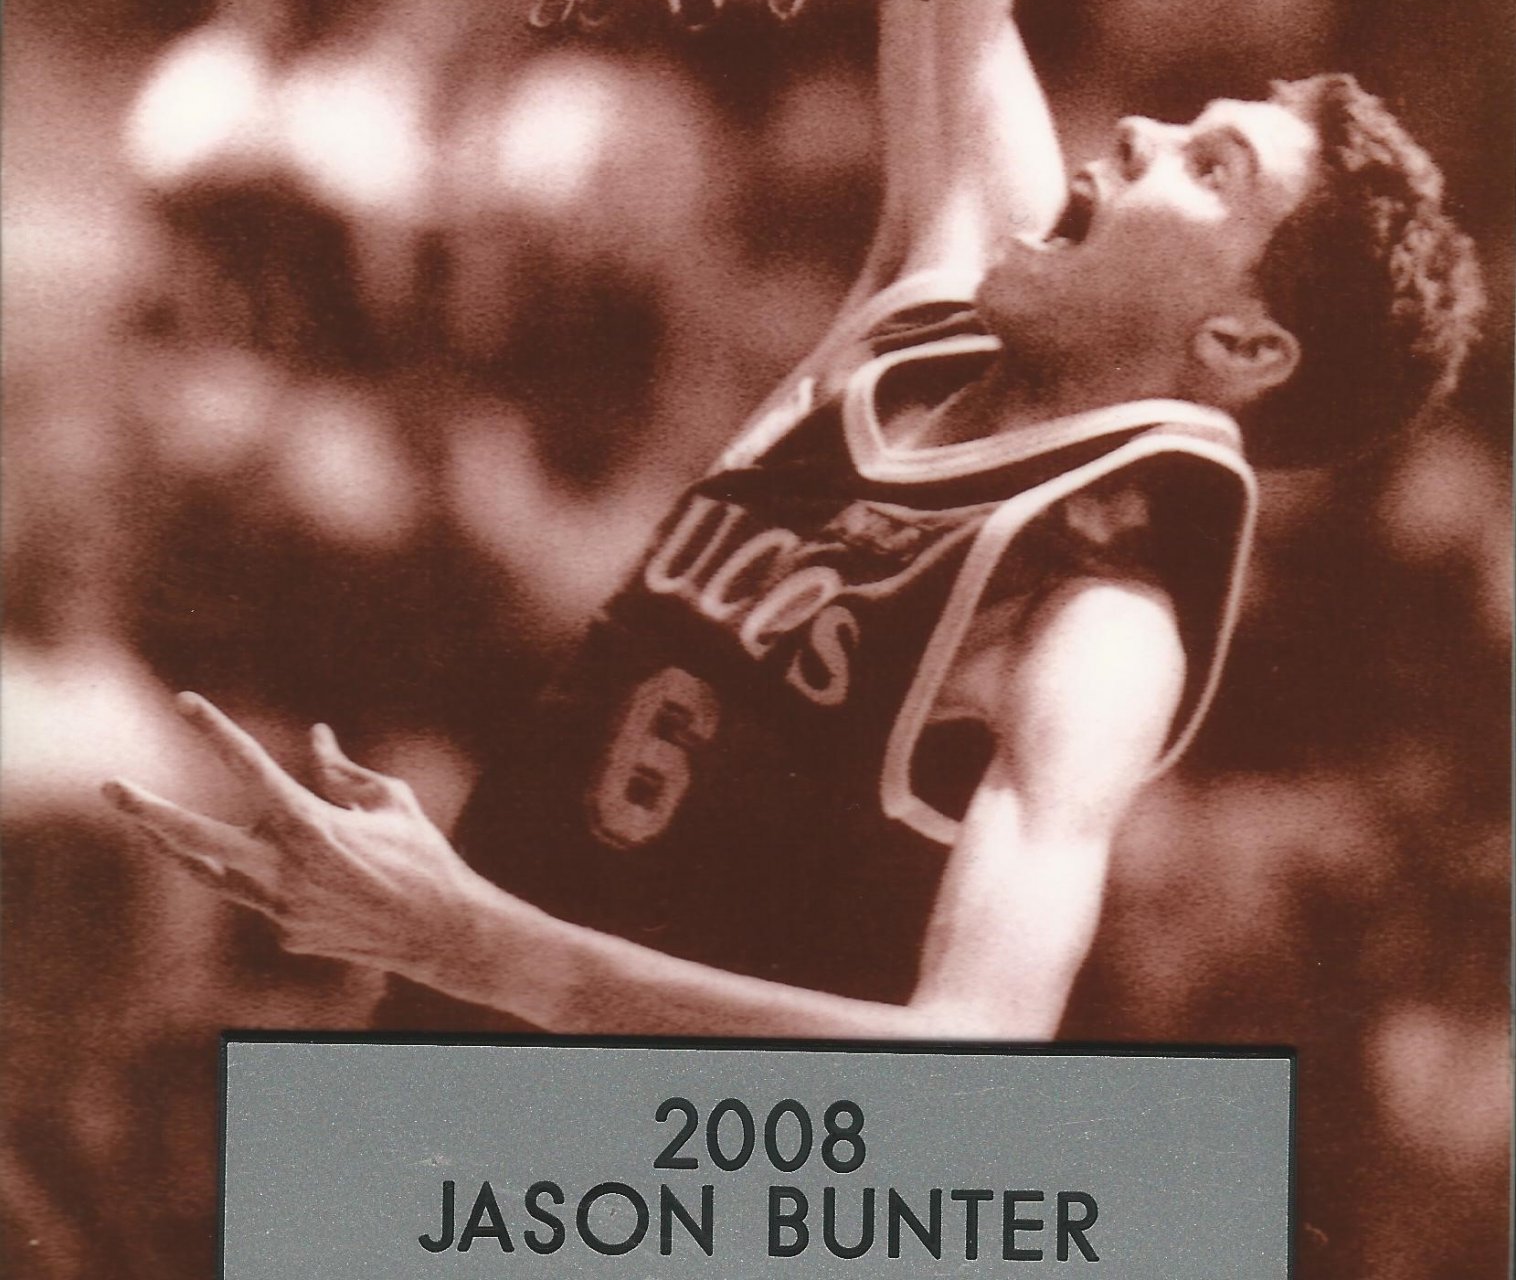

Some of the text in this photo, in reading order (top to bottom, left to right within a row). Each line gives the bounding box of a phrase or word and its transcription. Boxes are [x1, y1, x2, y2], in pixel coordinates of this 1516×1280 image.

[588, 666, 722, 848] 6
[653, 1096, 867, 1174] 2008
[418, 1179, 1101, 1263] JASON BUNTER
